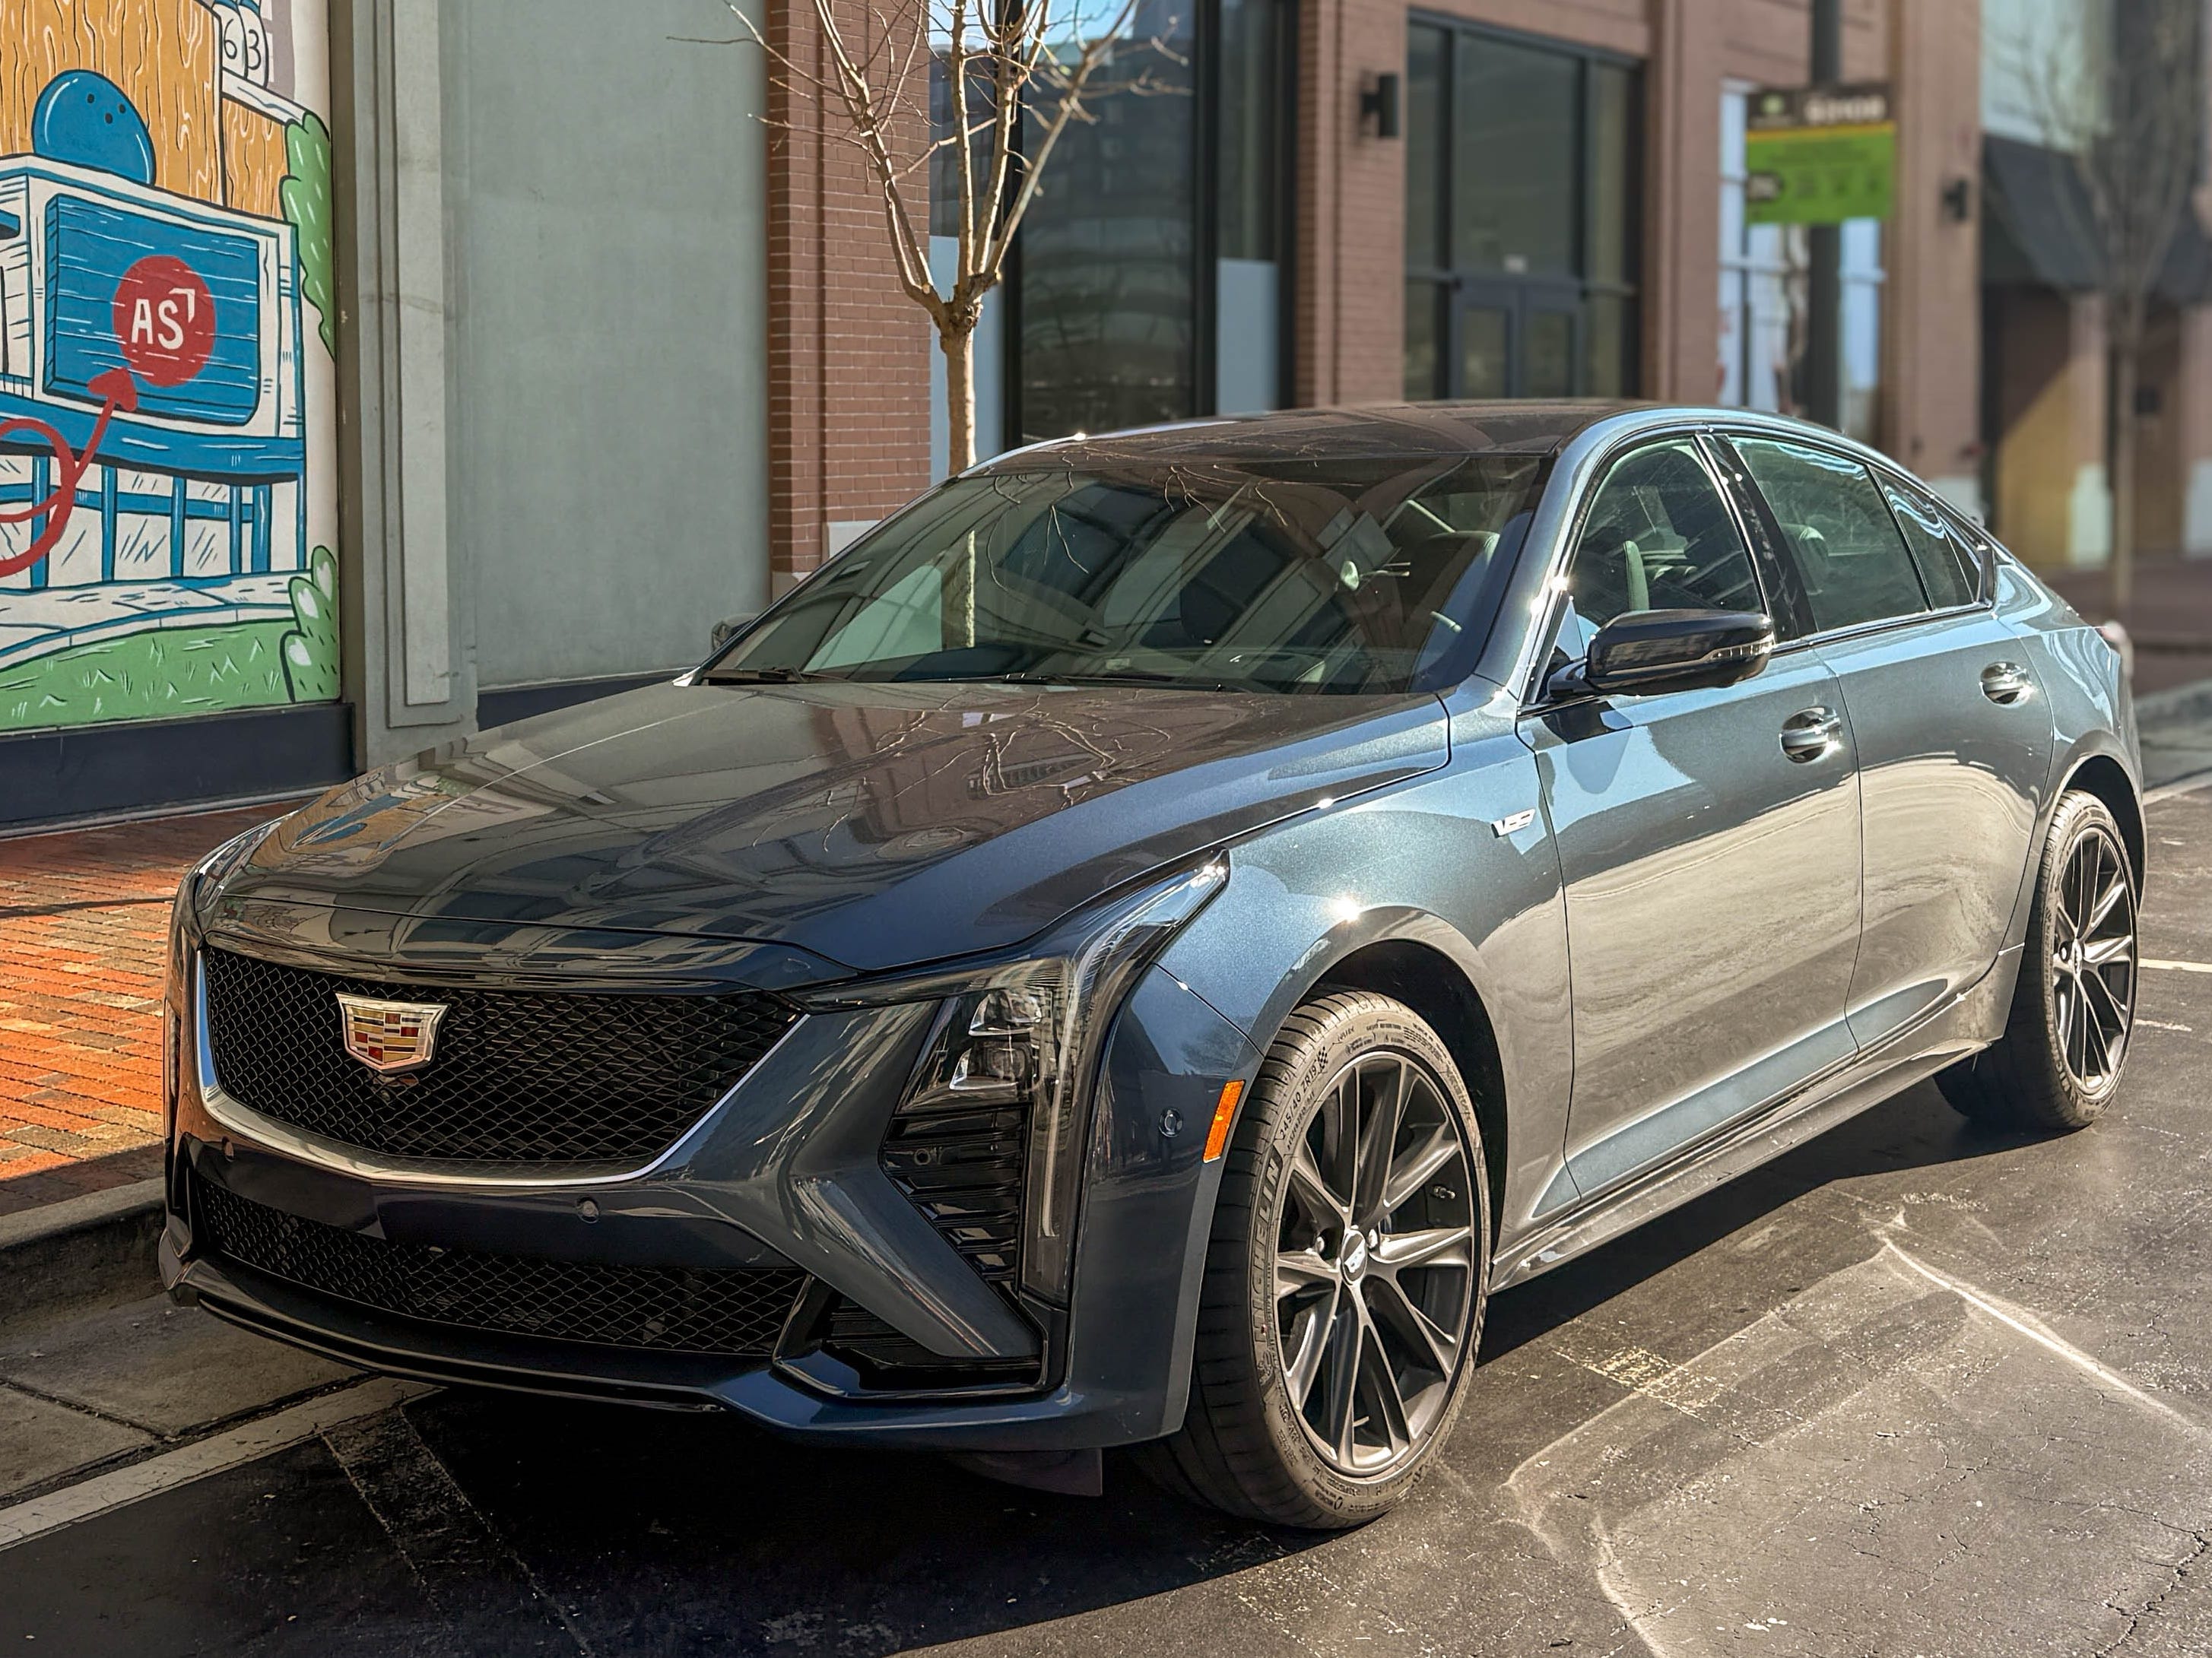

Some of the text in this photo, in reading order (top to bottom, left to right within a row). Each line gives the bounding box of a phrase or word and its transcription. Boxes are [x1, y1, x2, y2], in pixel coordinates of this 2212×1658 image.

[1279, 1092, 1302, 1140] 245/40
[1300, 1064, 1318, 1093] ZR19
[1252, 1157, 1279, 1343] MICHELIN
